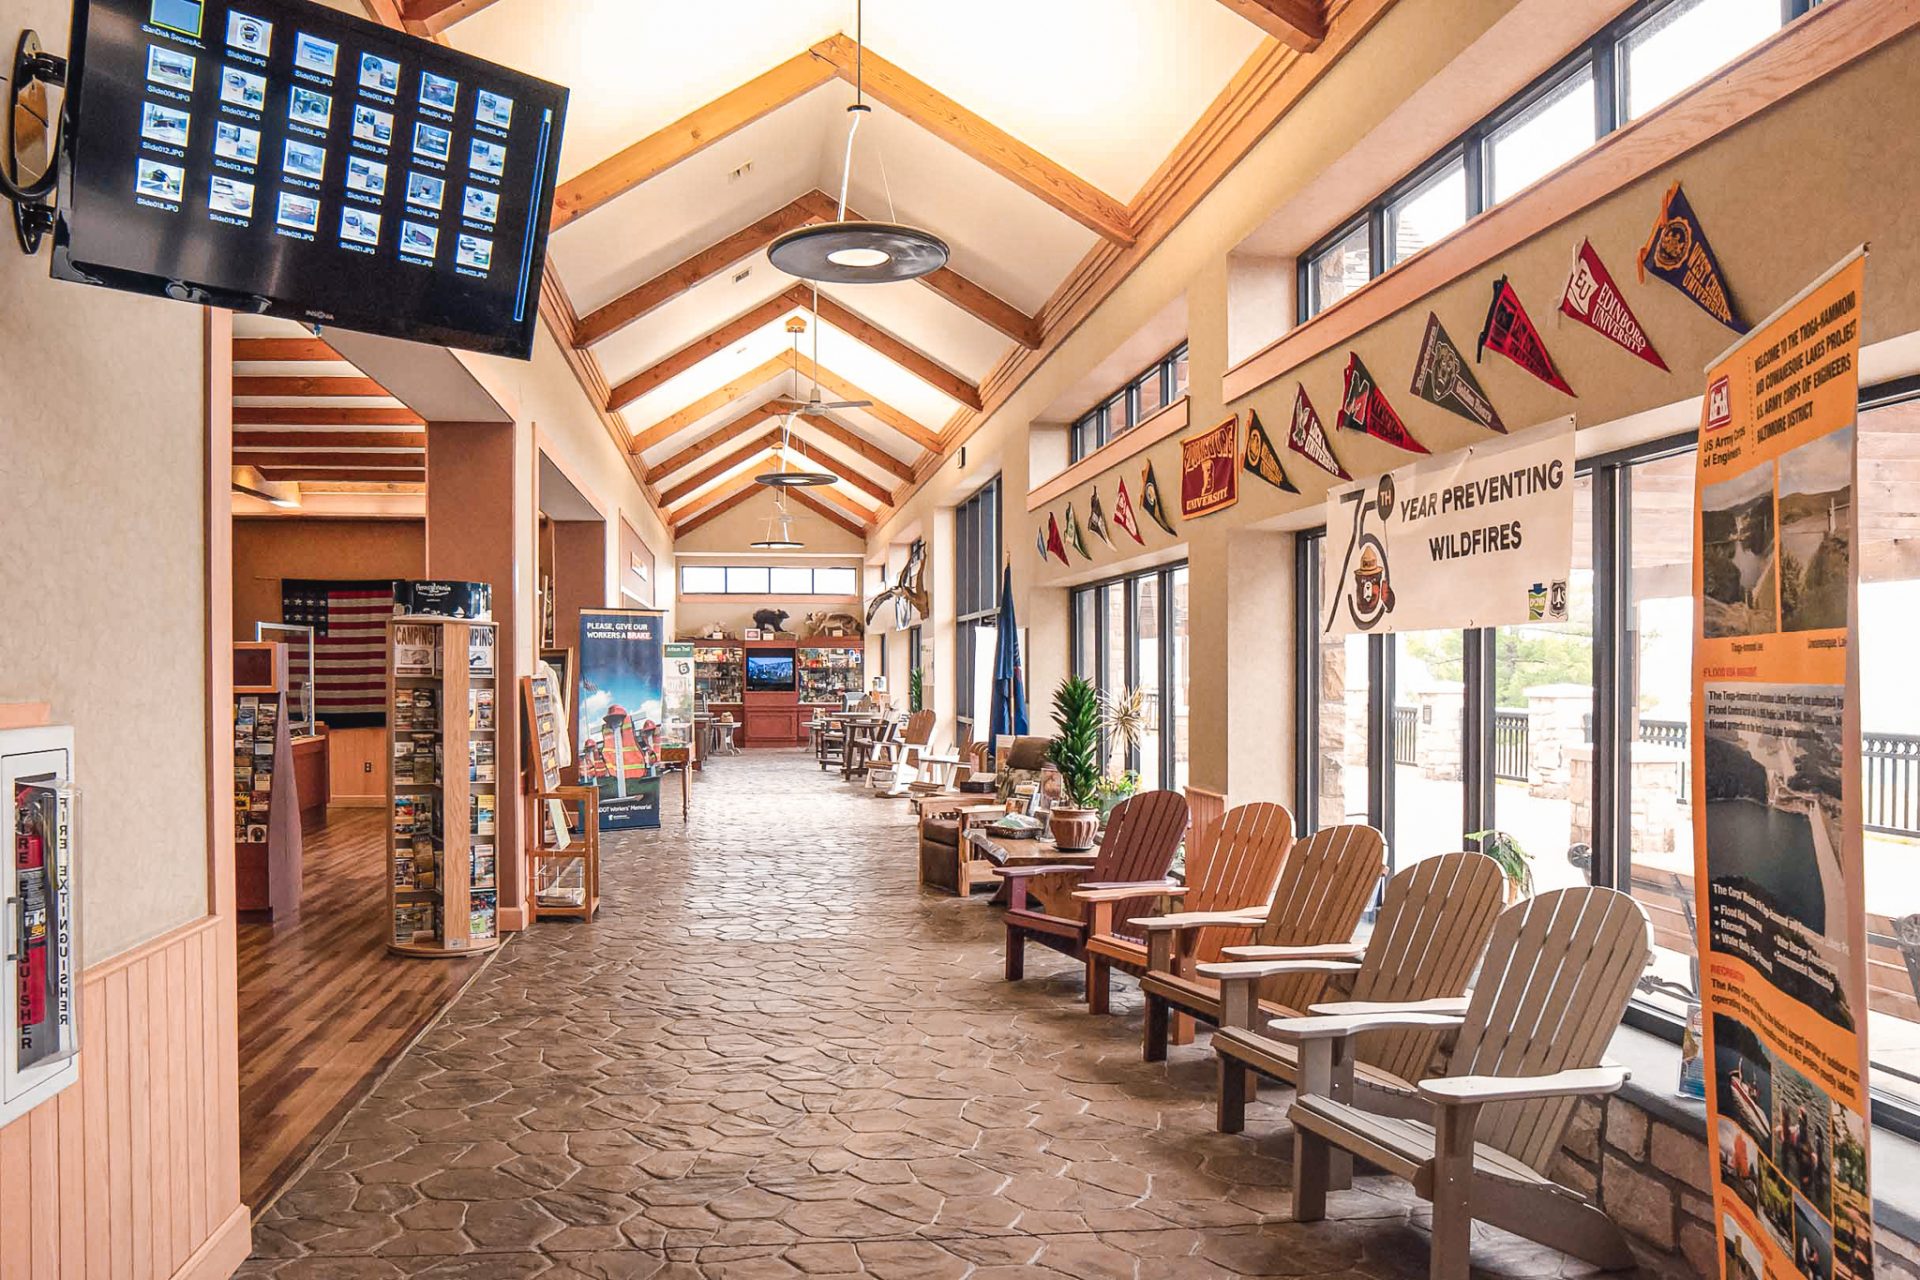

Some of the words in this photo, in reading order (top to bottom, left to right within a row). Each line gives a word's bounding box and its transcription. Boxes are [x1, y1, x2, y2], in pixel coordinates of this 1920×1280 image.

[1687, 241, 1712, 283] WEST
[1575, 269, 1592, 300] EU
[1682, 270, 1727, 323] UNIVERSITY
[1597, 281, 1646, 348] EDINBORO
[1591, 303, 1643, 354] UNIVERSITY
[1805, 339, 1825, 366] LAKES
[1764, 392, 1782, 414] ARMY
[1802, 374, 1812, 394] OF
[1813, 352, 1851, 389] ENGINEERS
[1704, 439, 1713, 452] US
[1715, 436, 1733, 449] Army
[1703, 455, 1710, 467] of
[1186, 486, 1228, 511] UNIVERSITY
[1400, 493, 1437, 523] YEAR
[1442, 459, 1564, 514] PREVENTING
[1429, 520, 1522, 562] WILDFIRES
[395, 626, 433, 646] CAMPING
[469, 626, 494, 647] MPING
[586, 622, 614, 631] PLEASE,
[1708, 691, 1722, 701] The
[1708, 705, 1727, 715] Flood
[1712, 883, 1728, 896] The
[1711, 978, 1726, 990] The
